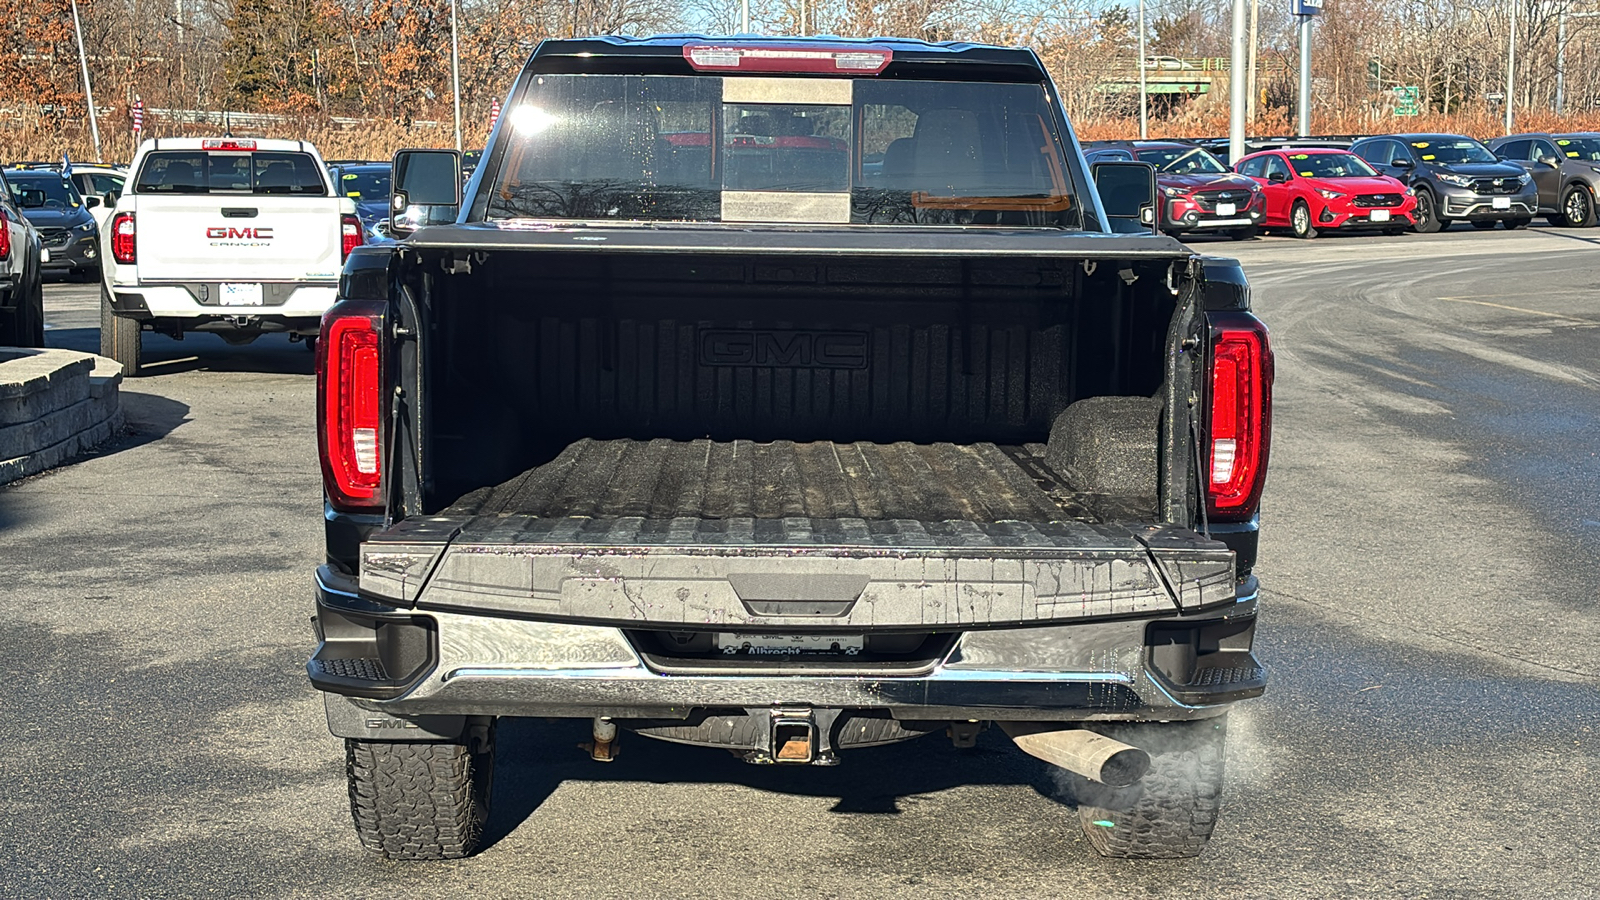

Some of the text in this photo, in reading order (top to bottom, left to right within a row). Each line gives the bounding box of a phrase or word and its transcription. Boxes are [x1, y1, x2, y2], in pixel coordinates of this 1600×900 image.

[206, 227, 273, 239] GMC
[703, 331, 864, 365] GMC
[748, 646, 801, 655] Albrecht
[365, 717, 420, 729] GMC
